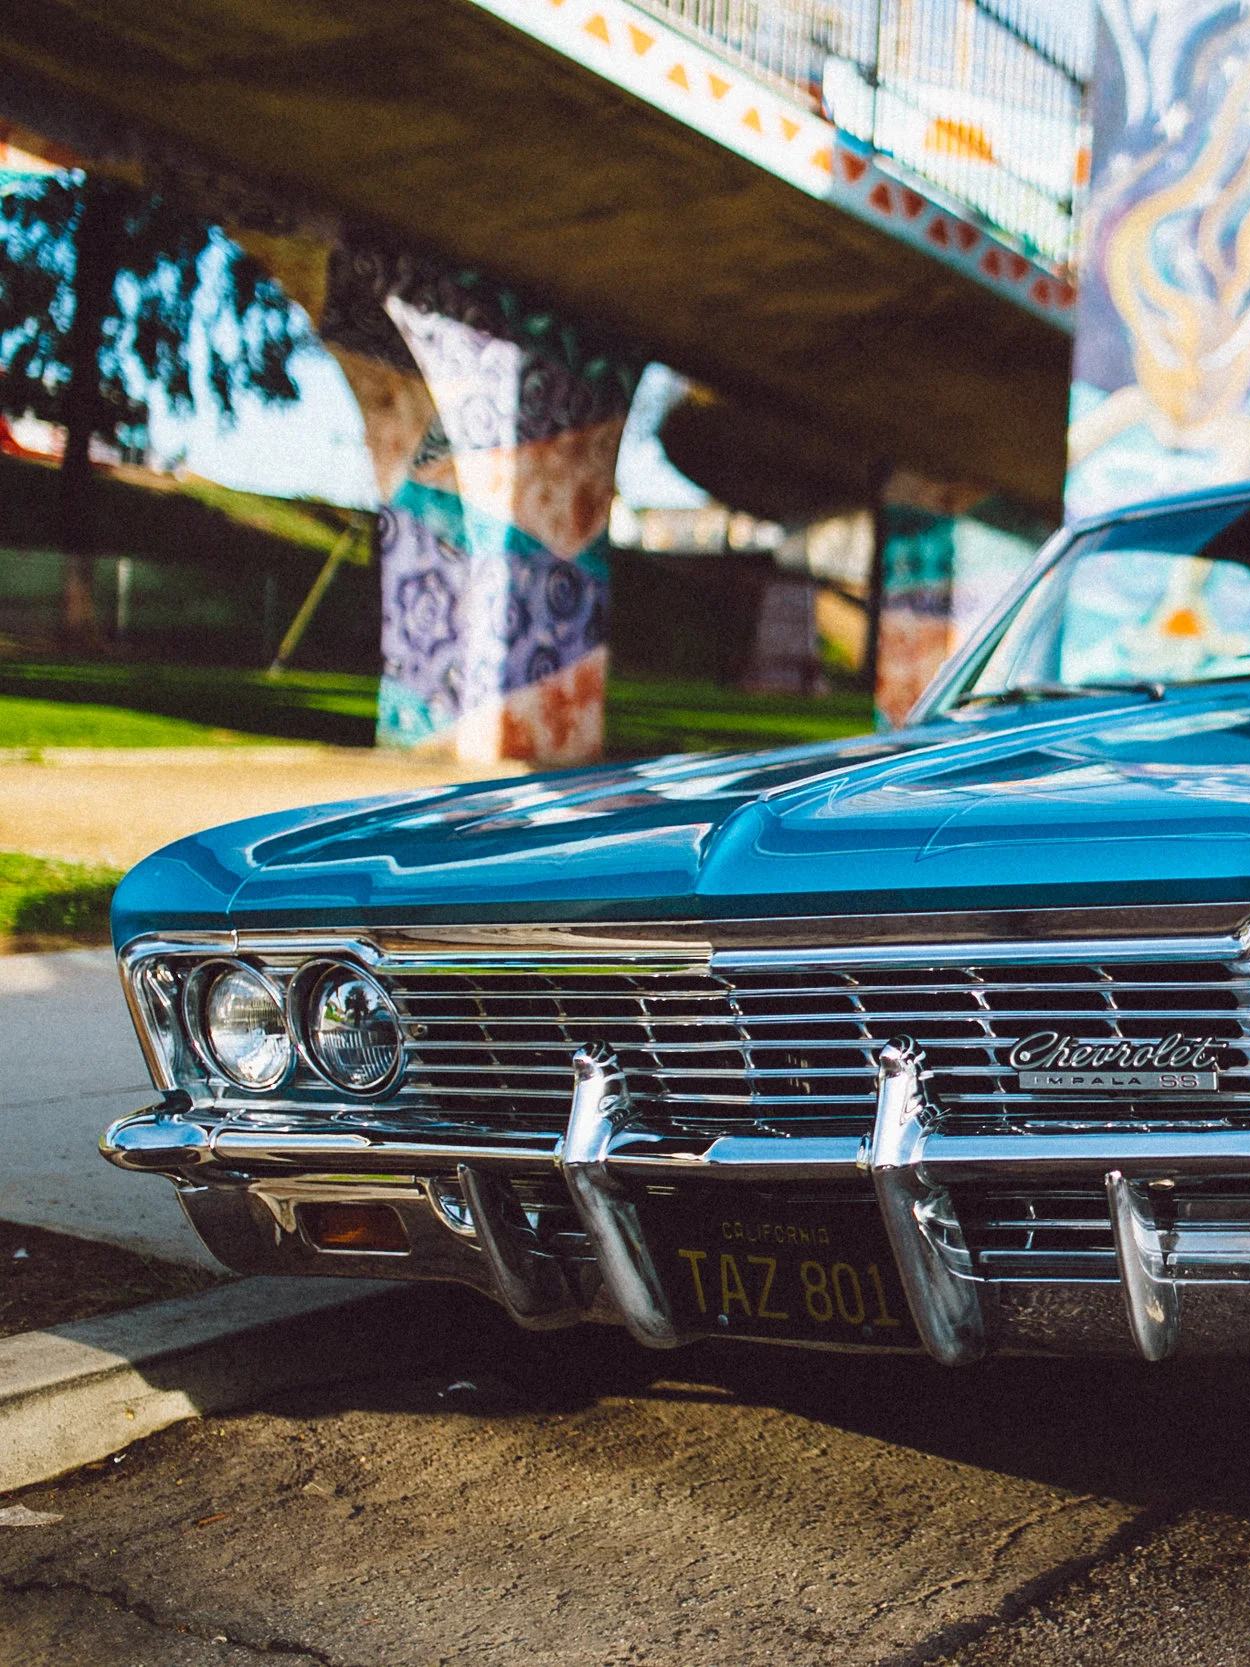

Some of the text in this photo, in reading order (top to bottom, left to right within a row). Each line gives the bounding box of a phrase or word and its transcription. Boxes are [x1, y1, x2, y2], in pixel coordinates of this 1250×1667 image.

[1010, 1030, 1227, 1070] Chevrolet
[1033, 1074, 1199, 1089] IMPALA SS
[722, 1222, 830, 1246] CALIFORNIA
[678, 1248, 901, 1328] TAZ 801
